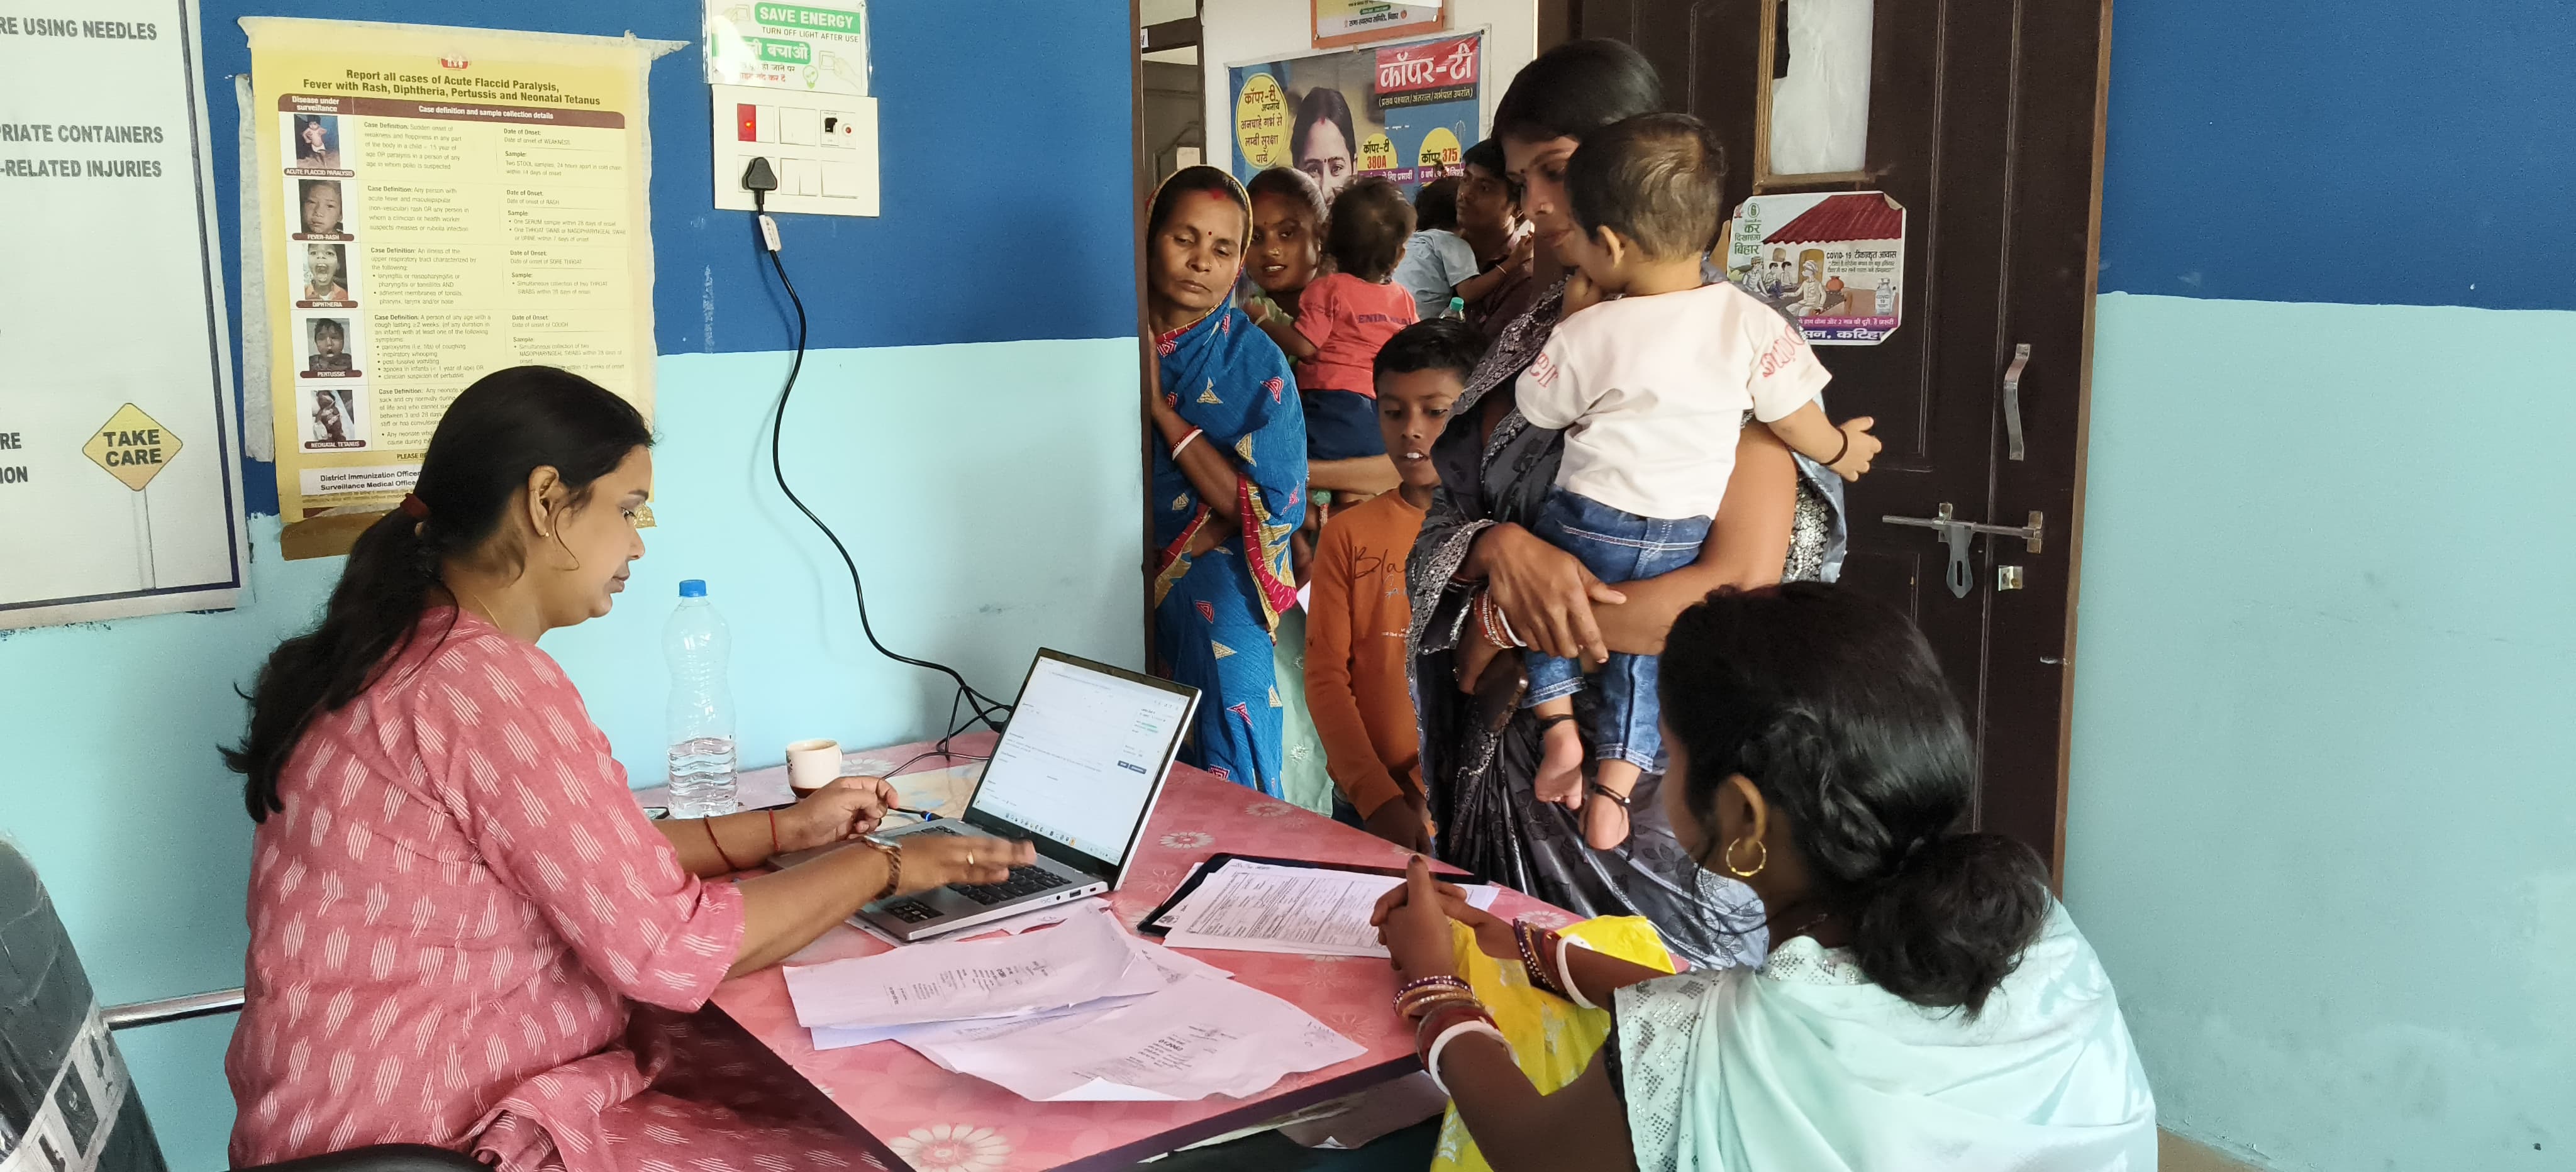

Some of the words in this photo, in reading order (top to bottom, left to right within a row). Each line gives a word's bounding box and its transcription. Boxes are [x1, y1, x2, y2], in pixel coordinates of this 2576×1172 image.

[760, 7, 796, 23] SAVE
[800, 11, 853, 30] ENERGY
[0, 17, 19, 35] RE
[23, 18, 78, 37] USING
[83, 21, 157, 40] NEEDLES
[762, 26, 782, 35] TURN
[784, 28, 797, 38] OFF
[799, 30, 818, 39] LIGHT
[821, 31, 843, 41] AFTER
[845, 35, 859, 43] USE
[767, 43, 808, 60] बचाओ
[1379, 43, 1474, 89] कॉपर-टी
[347, 69, 380, 81] Report
[384, 72, 396, 81] all
[399, 74, 428, 84] cases
[431, 75, 441, 84] of
[444, 76, 472, 87] Acute
[475, 78, 509, 89] Flaccid
[513, 80, 559, 92] Paralysis,
[292, 96, 319, 105] Disease
[303, 79, 333, 89] Fever
[336, 81, 358, 91] with
[362, 82, 391, 94] Rash,
[393, 84, 448, 97] Diphtheria,
[452, 88, 496, 99] Pertussis
[500, 92, 518, 100] and
[521, 92, 562, 103] Neonatal
[564, 94, 601, 105] Tetanus
[1244, 84, 1276, 104] कॉपर-टी
[435, 106, 464, 115] definition
[479, 109, 502, 118] sample
[502, 110, 532, 118] collection
[533, 111, 553, 119] details
[1241, 114, 1262, 130] अनचाहे
[1263, 113, 1275, 126] गर्भ
[1277, 113, 1282, 126] से
[0, 124, 53, 142] RIATE
[58, 125, 164, 143] CONTAINERS
[1245, 133, 1260, 146] लम्बी
[1261, 135, 1279, 149] सुरक्षा
[1363, 138, 1389, 154] कॉपर-टी
[1442, 147, 1458, 162] 375
[87, 160, 162, 177] INJURIES
[1367, 155, 1387, 169] 380A
[1745, 224, 1761, 233] कर
[1735, 241, 1761, 255] बिहार
[1836, 328, 1885, 340] कटिहा
[103, 429, 161, 447] TAKE
[105, 448, 162, 467] CARE
[348, 472, 395, 480] Immunization
